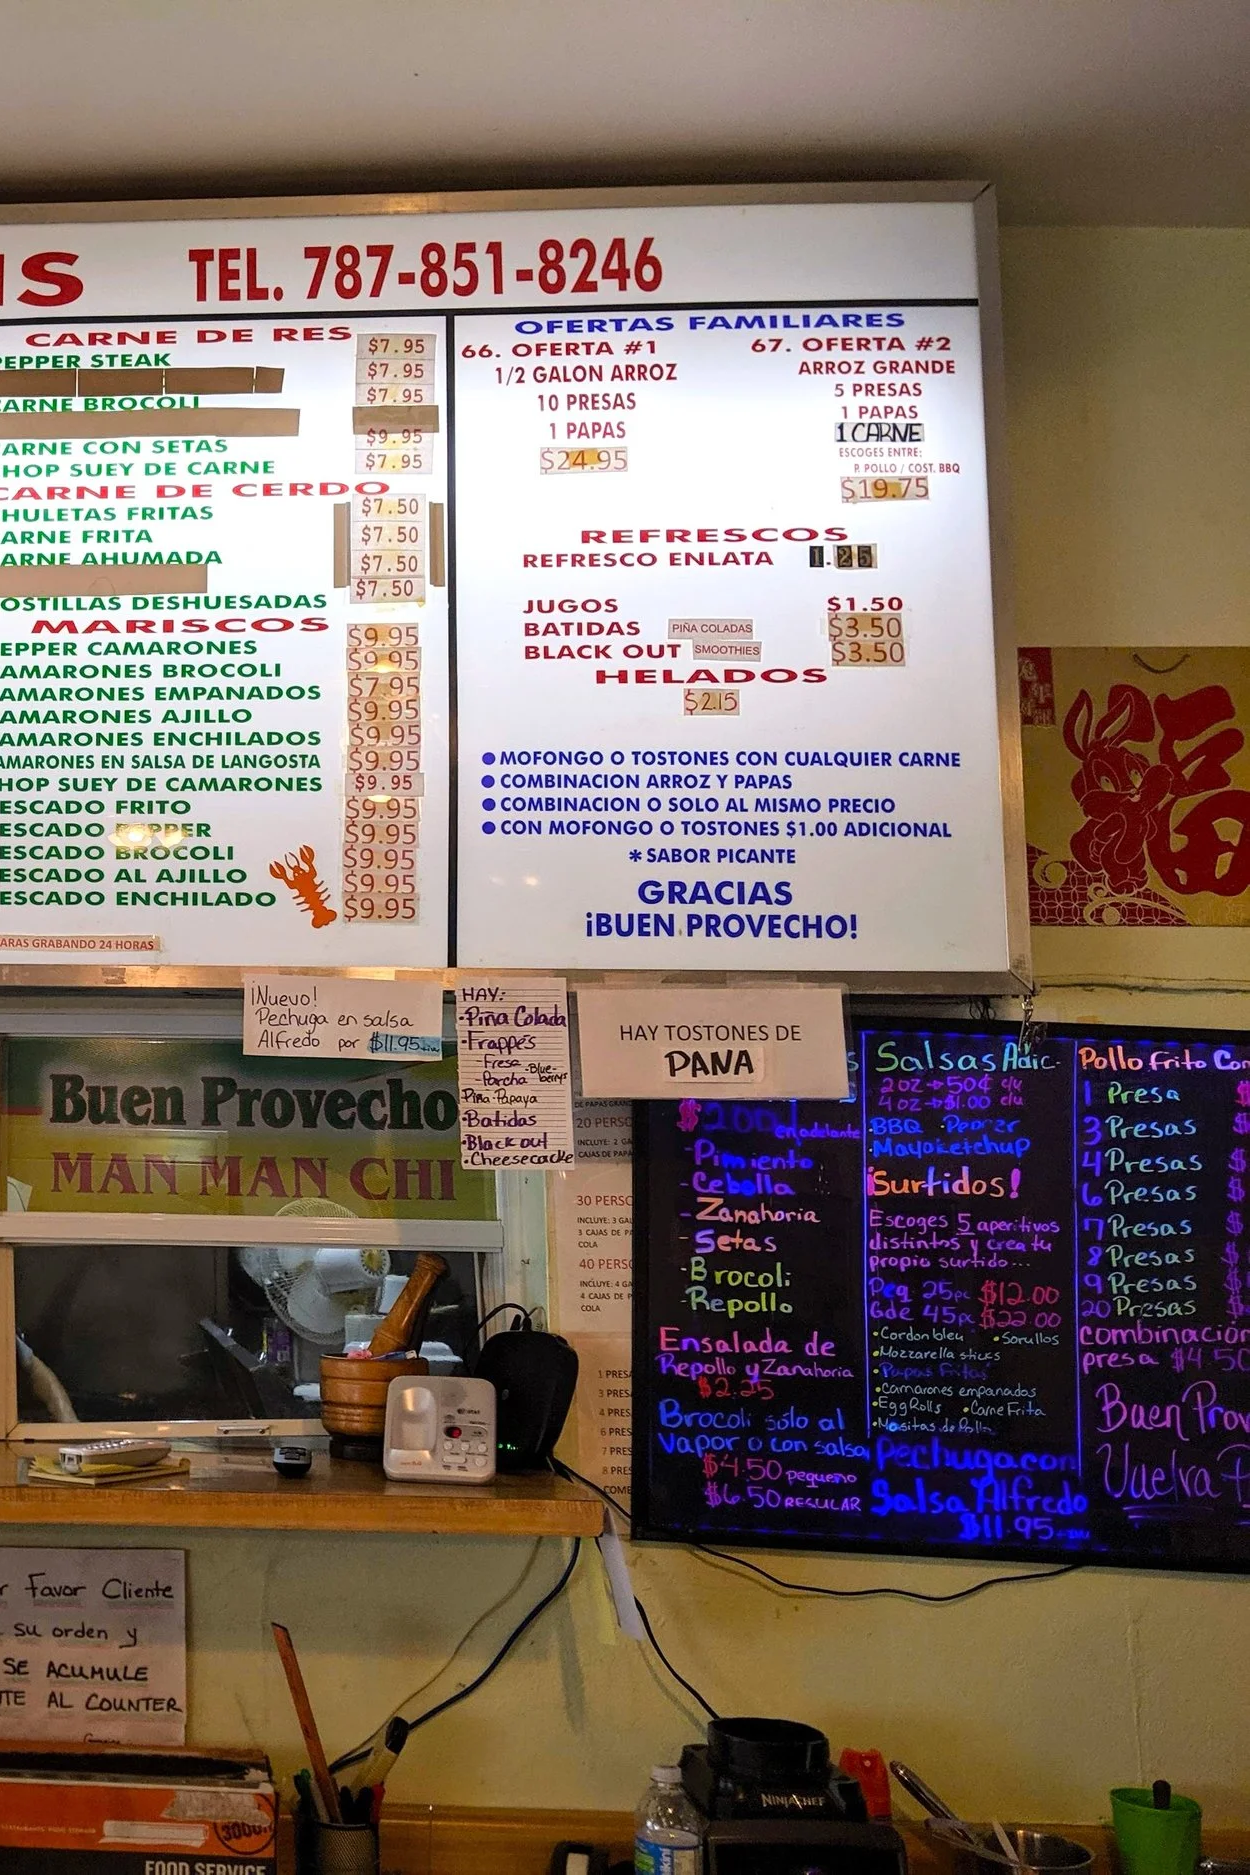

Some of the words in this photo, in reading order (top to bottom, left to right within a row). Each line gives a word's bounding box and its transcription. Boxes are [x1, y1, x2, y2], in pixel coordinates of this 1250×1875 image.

[189, 248, 283, 301] TEL.
[304, 237, 662, 299] 787-851-8246
[515, 317, 674, 334] OFERTAS
[690, 313, 904, 330] FAMILIARES
[26, 331, 176, 347] CARNE
[197, 329, 252, 343] DE
[274, 327, 351, 341] RES
[839, 447, 884, 459] ESCOGES
[887, 447, 923, 458] ENTRE:
[582, 528, 847, 543] REFRESCOS
[524, 553, 657, 567] REFRESCO
[670, 552, 773, 566] ENLATA
[31, 618, 329, 633] MARISCOS
[671, 622, 697, 635] PIÑA
[699, 622, 754, 635] COLADAS
[694, 644, 761, 657] SMOOTHIES
[596, 669, 827, 684] HELADOS
[102, 755, 124, 769] EN
[132, 755, 185, 769] SALSA
[193, 755, 214, 768] DE
[222, 754, 320, 768] LANGOSTA
[501, 820, 541, 834] CON
[549, 820, 653, 835] MOFONGO
[660, 821, 674, 835] O
[681, 821, 779, 836] TOSTONES
[787, 821, 837, 838] $1.00
[844, 822, 952, 837] ADICIONAL
[647, 848, 710, 863] SABOR
[718, 849, 795, 863] PICANTE
[638, 880, 792, 906] GRACIAS
[344, 889, 415, 922] $9.95
[586, 912, 674, 937] ¡BUEN
[687, 914, 857, 939] PROVECHO!
[32, 939, 96, 949] GRABANDO
[99, 940, 111, 950] 24
[115, 940, 154, 950] HORAS
[251, 981, 317, 1007] ¡Nuevo!
[462, 987, 506, 1001] HAY:
[255, 1007, 328, 1033] Pechuga
[337, 1015, 358, 1025] en
[363, 1010, 414, 1028] salsa
[514, 1004, 566, 1027] Colada
[258, 1030, 320, 1048] Alfredo
[338, 1038, 360, 1053] por
[370, 1032, 420, 1053] $11.95
[620, 1025, 658, 1041] HAY
[664, 1025, 769, 1041] TOSTONES
[776, 1025, 801, 1041] DE
[484, 1054, 521, 1068] Fresa
[664, 1050, 754, 1077] PANA
[876, 1040, 997, 1072] Salsas
[1079, 1045, 1143, 1071] Pollo
[49, 1073, 190, 1131] Buen
[200, 1076, 460, 1131] Provecho
[465, 1110, 536, 1127] Batidas
[466, 1134, 516, 1150] Black
[520, 1132, 548, 1149] out
[1083, 1116, 1102, 1145] 3
[1105, 1115, 1197, 1139] Presas
[52, 1152, 180, 1195] MAN
[198, 1156, 331, 1199] MAN
[350, 1159, 455, 1200] CHI
[692, 1172, 795, 1196] Cebolla
[577, 1195, 591, 1206] 30
[696, 1197, 821, 1224] Zanahoria
[869, 1209, 948, 1234] Escoges
[977, 1216, 1060, 1233] aperitivos
[695, 1229, 777, 1254] Setas
[690, 1257, 791, 1287] Brocoli
[685, 1286, 793, 1318] Repollo
[660, 1327, 792, 1354] Ensalada
[805, 1331, 836, 1356] de
[1002, 1332, 1059, 1345] Sorullos
[880, 1346, 955, 1360] Mozzarella
[882, 1383, 953, 1396] Camarones
[959, 1384, 1036, 1397] empanados
[25, 1572, 87, 1599] Favor
[102, 1579, 174, 1600] Cliente
[13, 1622, 43, 1638] su
[52, 1621, 109, 1640] orden
[119, 1627, 138, 1648] y
[3, 1656, 30, 1676] SE
[46, 1663, 149, 1683] ACUMULE
[47, 1691, 74, 1709] AL
[85, 1695, 183, 1713] COUNTER
[145, 1860, 190, 1875] FOOD
[195, 1863, 266, 1875] SERVICE
